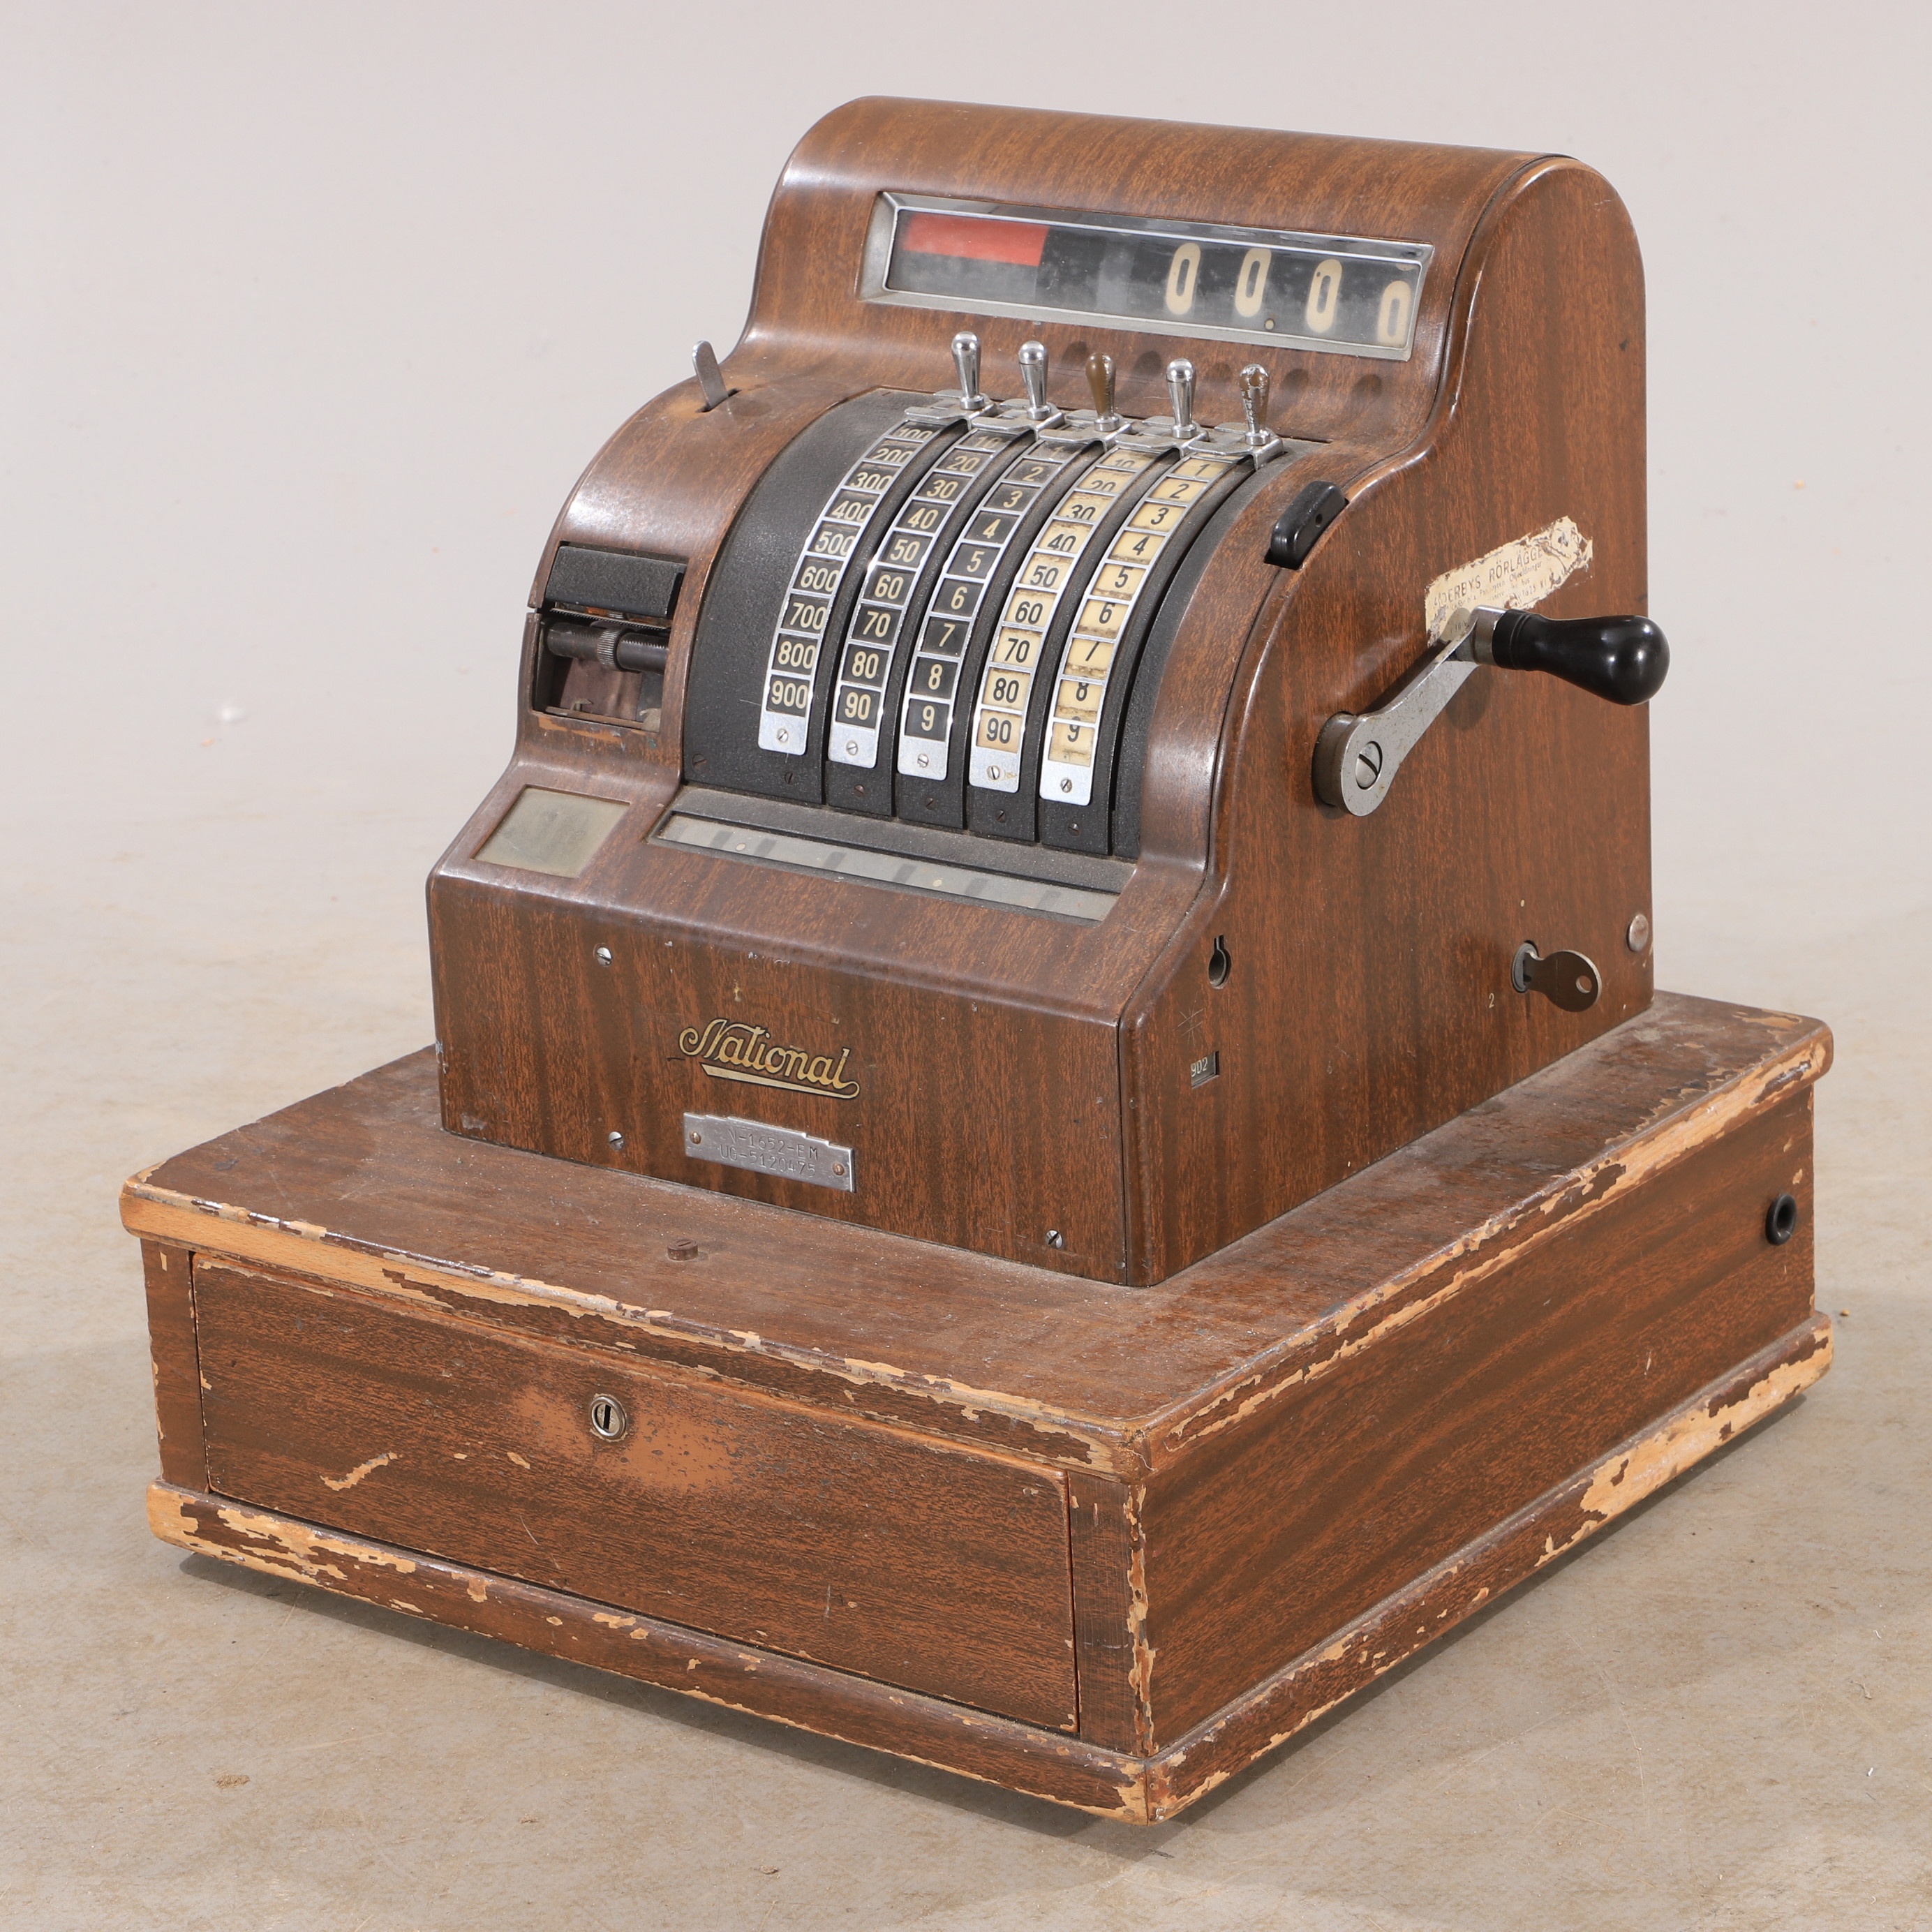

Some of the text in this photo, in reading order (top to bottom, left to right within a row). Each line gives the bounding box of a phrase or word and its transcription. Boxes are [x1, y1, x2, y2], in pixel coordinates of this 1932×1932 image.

[1166, 243, 1411, 345] 0 0 0 0
[898, 428, 934, 439] 100
[974, 435, 1003, 449] 10
[875, 447, 914, 463] 200
[946, 455, 981, 472] 20
[851, 471, 894, 491] 300
[1023, 466, 1044, 482] 2
[1194, 463, 1212, 477] 1
[926, 479, 958, 499] 30
[1090, 480, 1117, 492] 20
[1168, 483, 1190, 499] 2
[1003, 491, 1023, 508] 3
[831, 500, 874, 522] 400
[907, 507, 939, 530] 40
[1067, 504, 1097, 521] 30
[1150, 507, 1169, 525] 3
[983, 519, 1002, 539] 4
[815, 531, 856, 556] 500
[890, 539, 921, 563] 50
[1047, 533, 1077, 553] 40
[1132, 536, 1150, 556] 4
[967, 551, 985, 572] 5
[800, 565, 840, 592] 600
[875, 574, 904, 600] 60
[1030, 565, 1060, 588] 50
[1115, 567, 1133, 588] 5
[951, 586, 967, 610] 6
[789, 602, 827, 630] 700
[1015, 600, 1043, 625] 60
[1099, 602, 1115, 624] 6
[862, 611, 891, 638] 70
[939, 623, 956, 648] 7
[778, 641, 817, 669] 800
[1004, 638, 1030, 663] 70
[852, 651, 879, 679] 80
[928, 664, 943, 690] 8
[771, 680, 808, 709] 900
[993, 677, 1020, 703] 80
[1076, 681, 1090, 701] 8
[845, 692, 871, 720] 90
[921, 705, 935, 731] 9
[986, 718, 1012, 743] 90
[1067, 722, 1081, 742] 9
[1488, 993, 1495, 1009] 2
[678, 1018, 861, 1099] National
